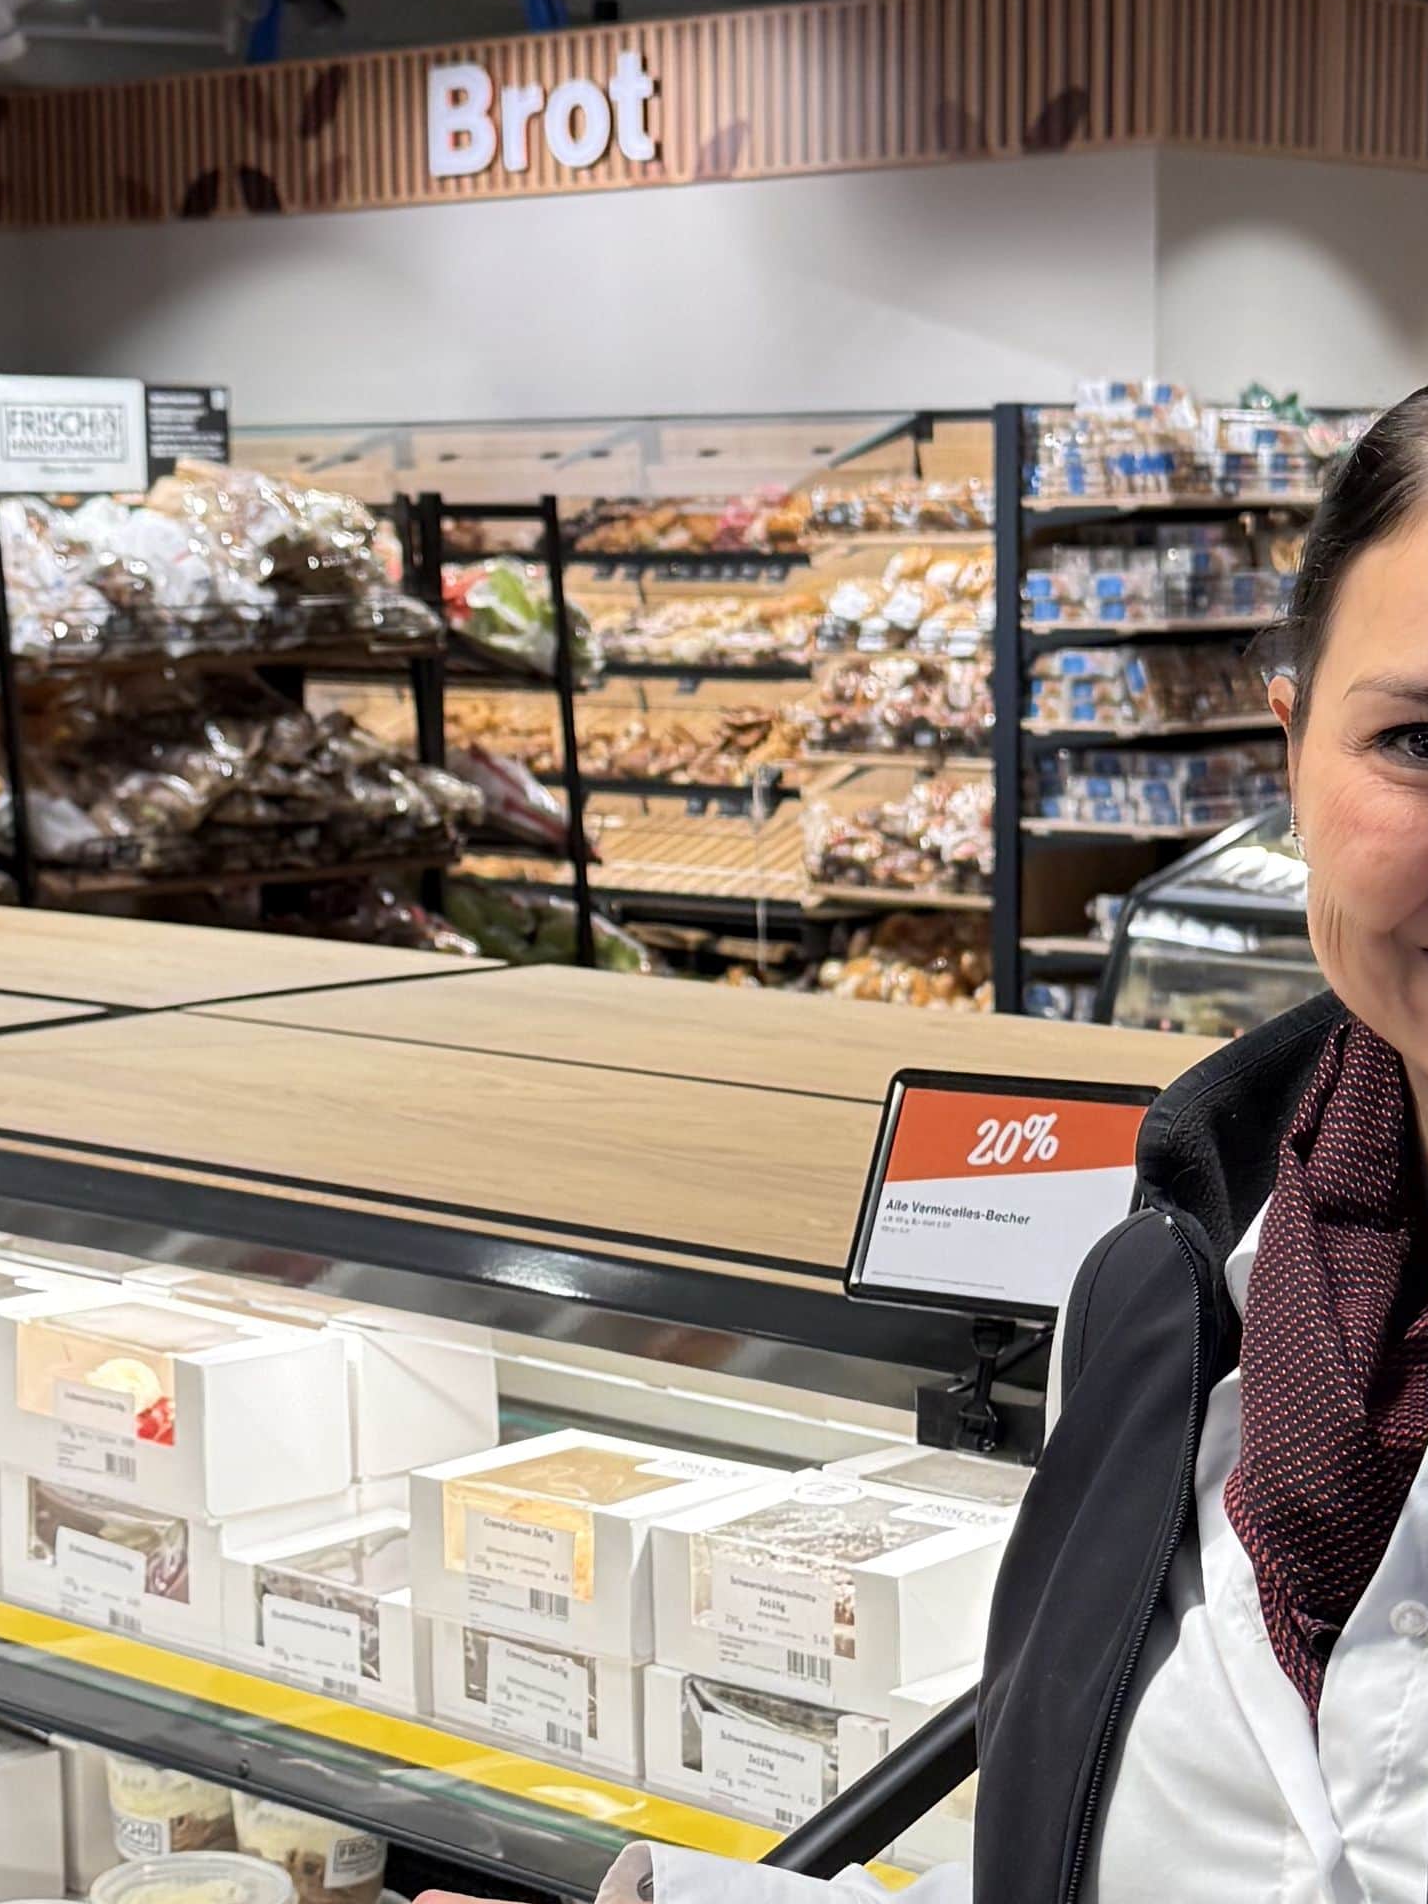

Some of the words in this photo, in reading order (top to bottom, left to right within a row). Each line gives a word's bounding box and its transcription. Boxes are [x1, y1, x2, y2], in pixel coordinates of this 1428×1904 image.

[428, 51, 655, 177] Brot
[967, 1113, 1059, 1165] 20%
[886, 1199, 909, 1212] Alle
[912, 1201, 1031, 1225] Vermicelles-Becher
